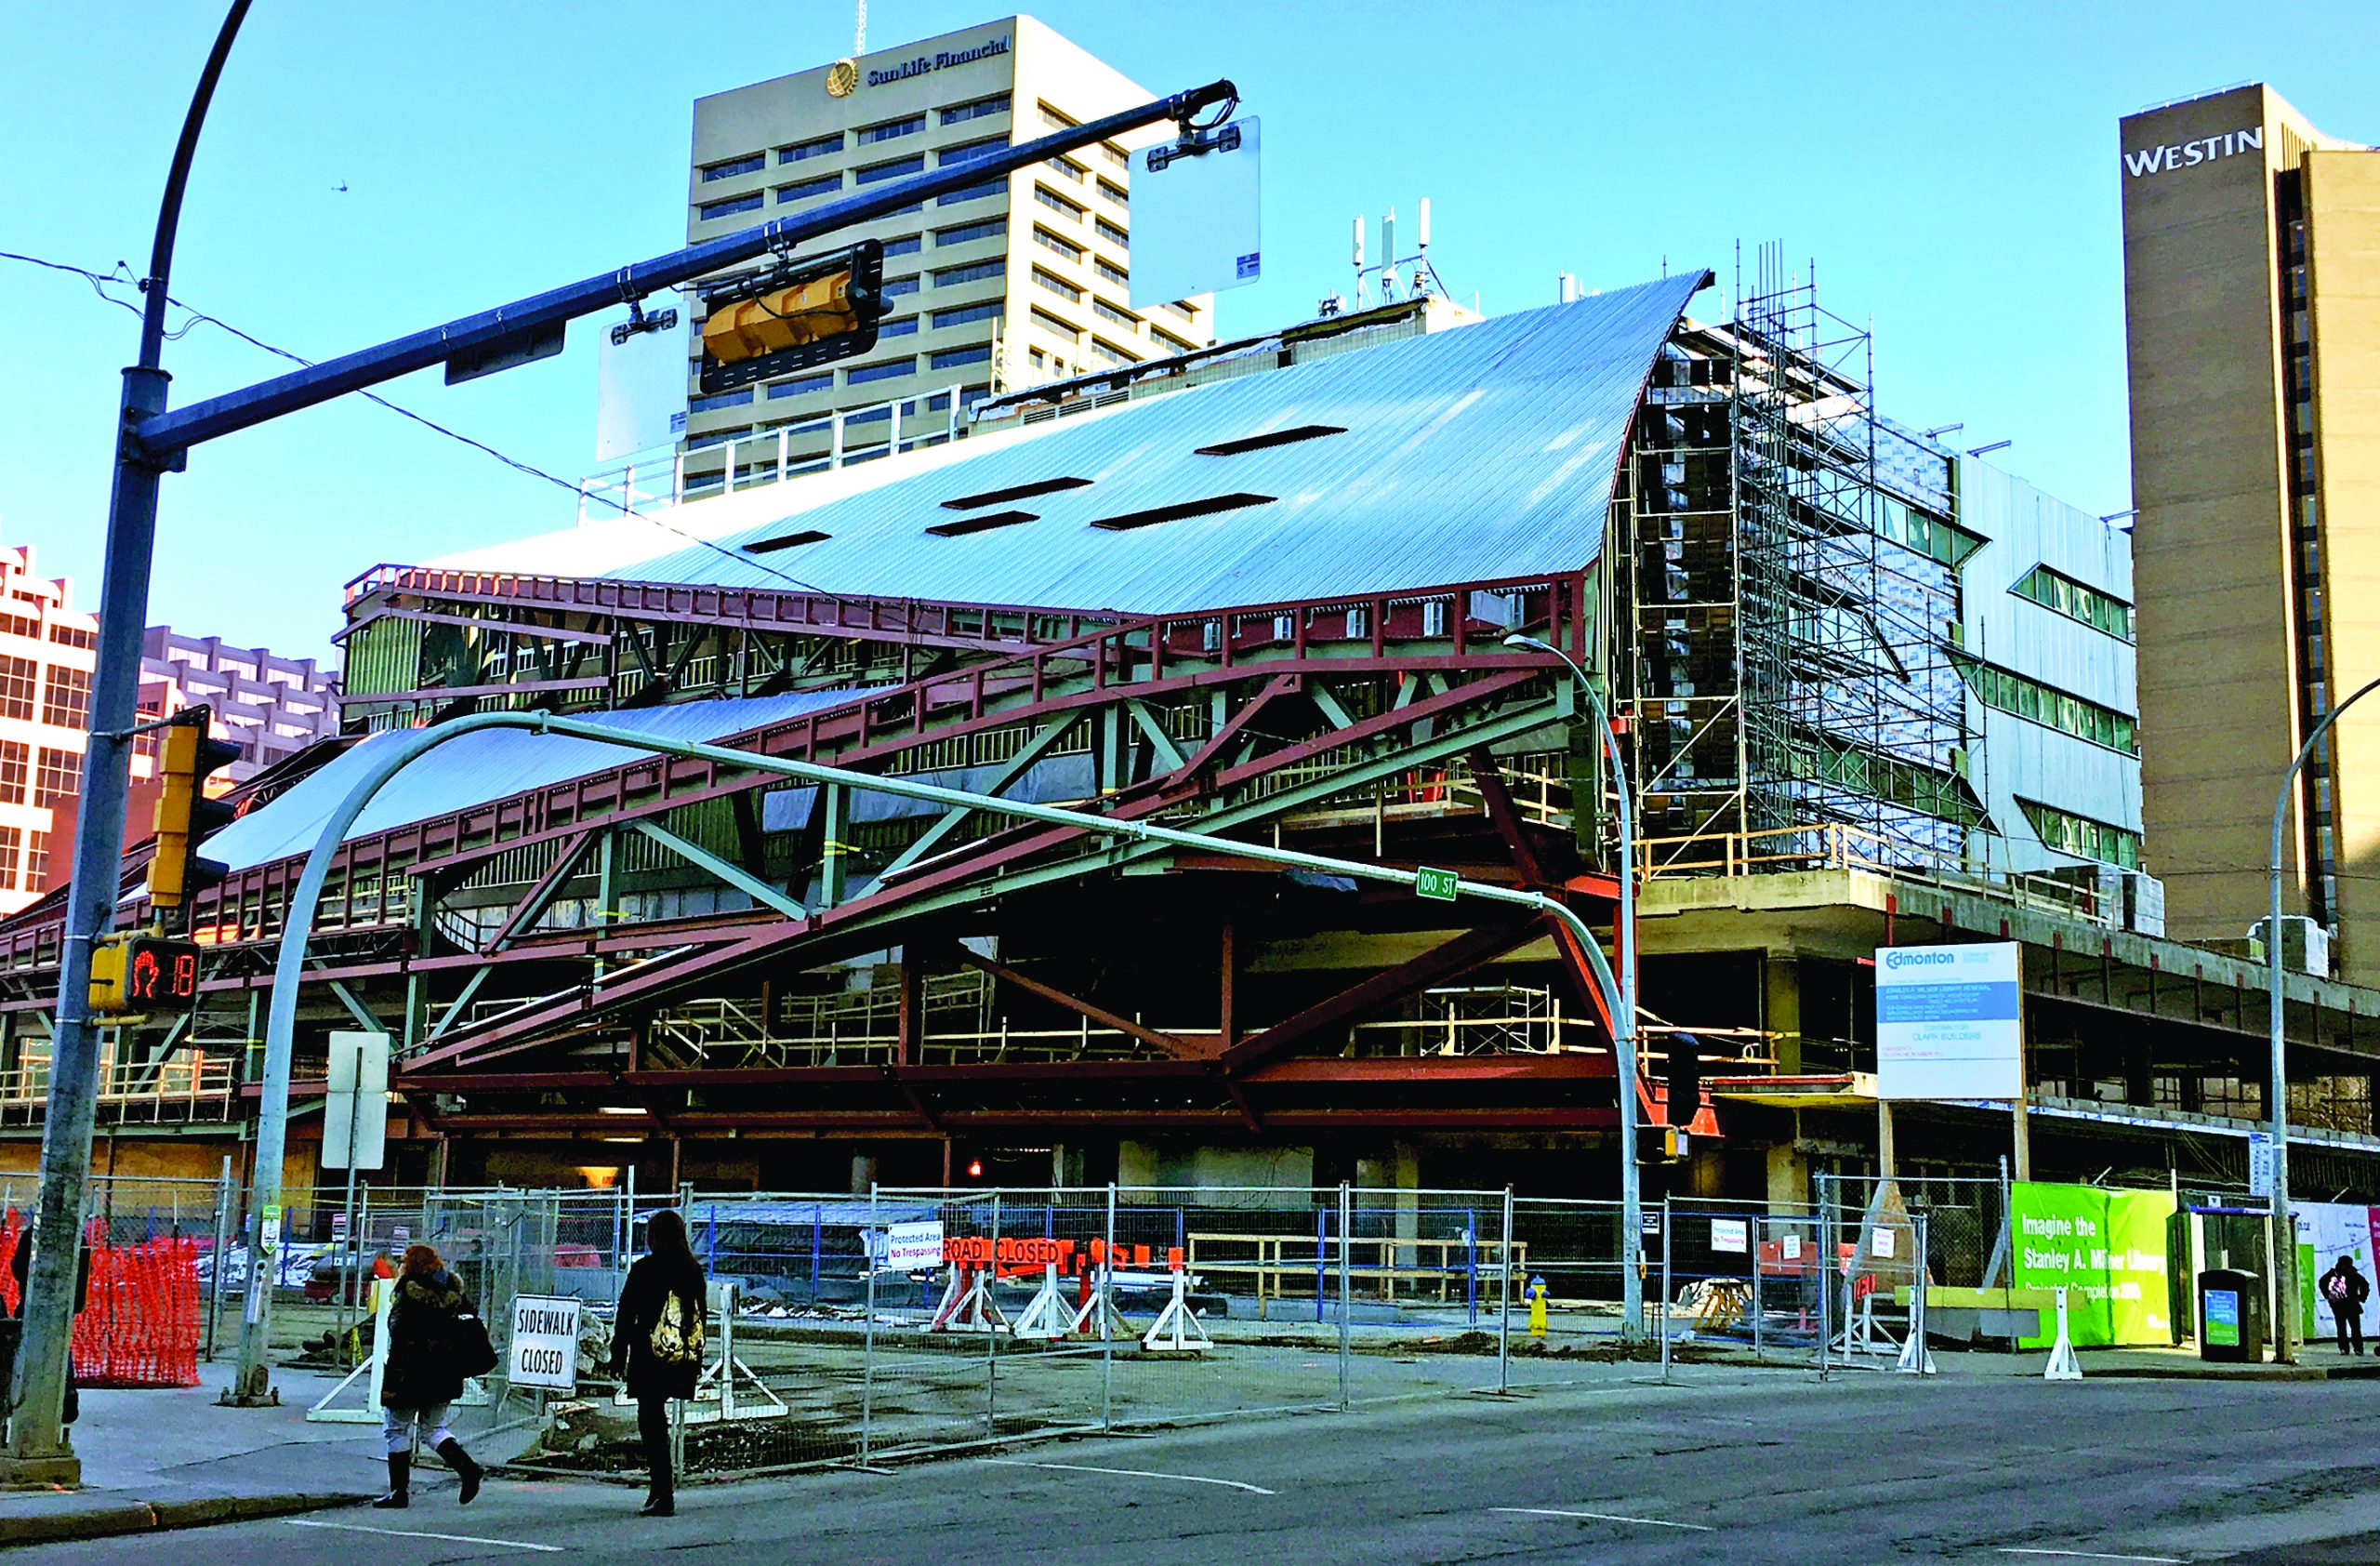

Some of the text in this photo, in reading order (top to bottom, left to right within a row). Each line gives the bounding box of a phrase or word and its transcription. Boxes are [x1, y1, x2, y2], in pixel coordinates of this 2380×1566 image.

[933, 35, 1011, 71] Financial
[2124, 126, 2262, 177] WESTIN
[1421, 873, 1454, 895] 100 ST
[1886, 951, 1954, 969] Edmonton
[172, 955, 194, 997] 18
[891, 1232, 941, 1244] Protected Area
[2022, 1214, 2096, 1241] Imagine the
[891, 1246, 941, 1258] No Trespassing
[943, 1240, 1058, 1263] ROAD CLOSED
[2024, 1247, 2069, 1273] Stanley
[2073, 1249, 2086, 1269] A.
[518, 1309, 575, 1335] SIDEWALK
[522, 1348, 562, 1374] CLOSED
